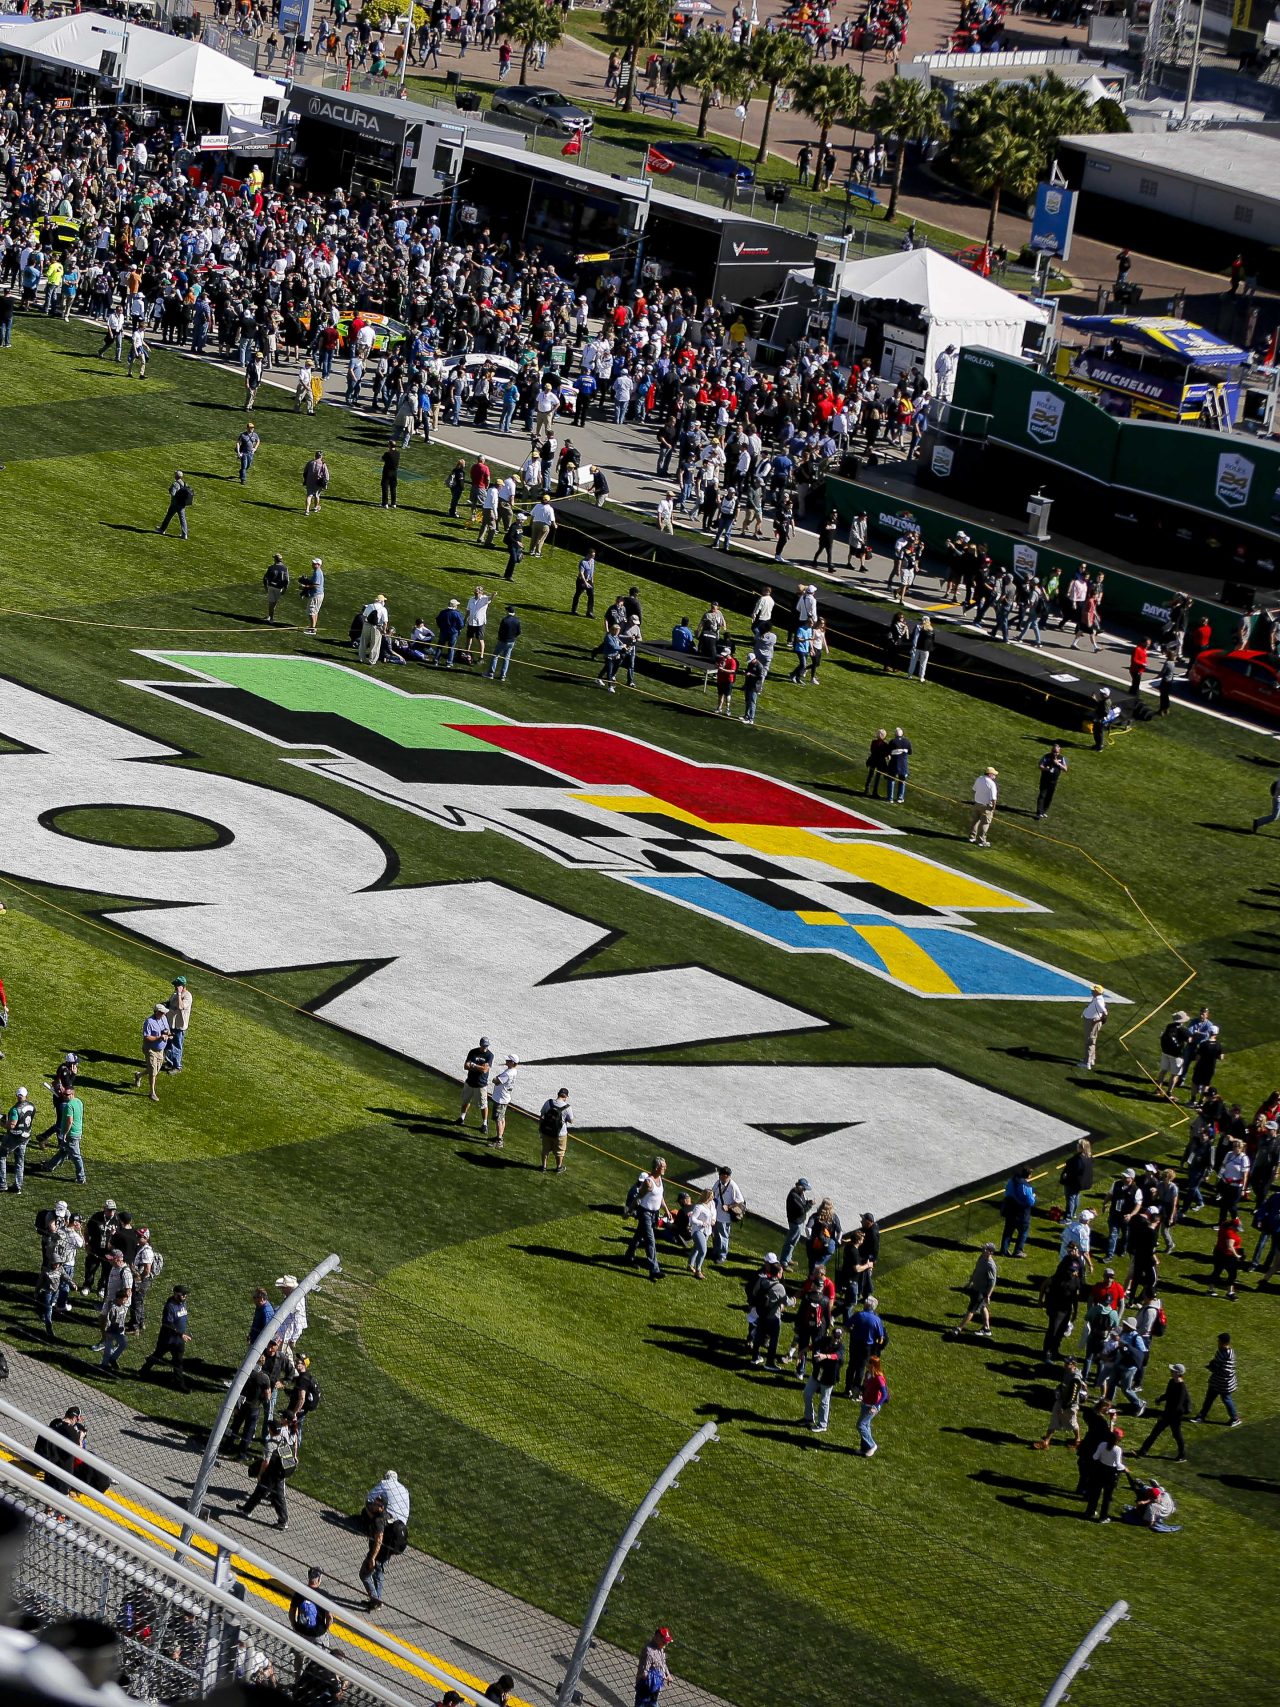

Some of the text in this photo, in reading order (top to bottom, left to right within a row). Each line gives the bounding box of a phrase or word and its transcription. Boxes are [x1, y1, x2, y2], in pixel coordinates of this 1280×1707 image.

[319, 101, 380, 132] ACURA
[964, 353, 994, 368] #ROLEX24
[1091, 368, 1163, 398] MICHELIN
[1036, 400, 1057, 413] ROLEX
[1031, 408, 1058, 427] 24
[1030, 425, 1054, 438] DAYTONA
[933, 456, 950, 466] 24
[1220, 471, 1248, 489] 24
[1219, 487, 1245, 501] DAYTONA
[878, 512, 921, 534] DAYTONA
[1016, 556, 1035, 569] 24
[1142, 602, 1172, 620] DAYT
